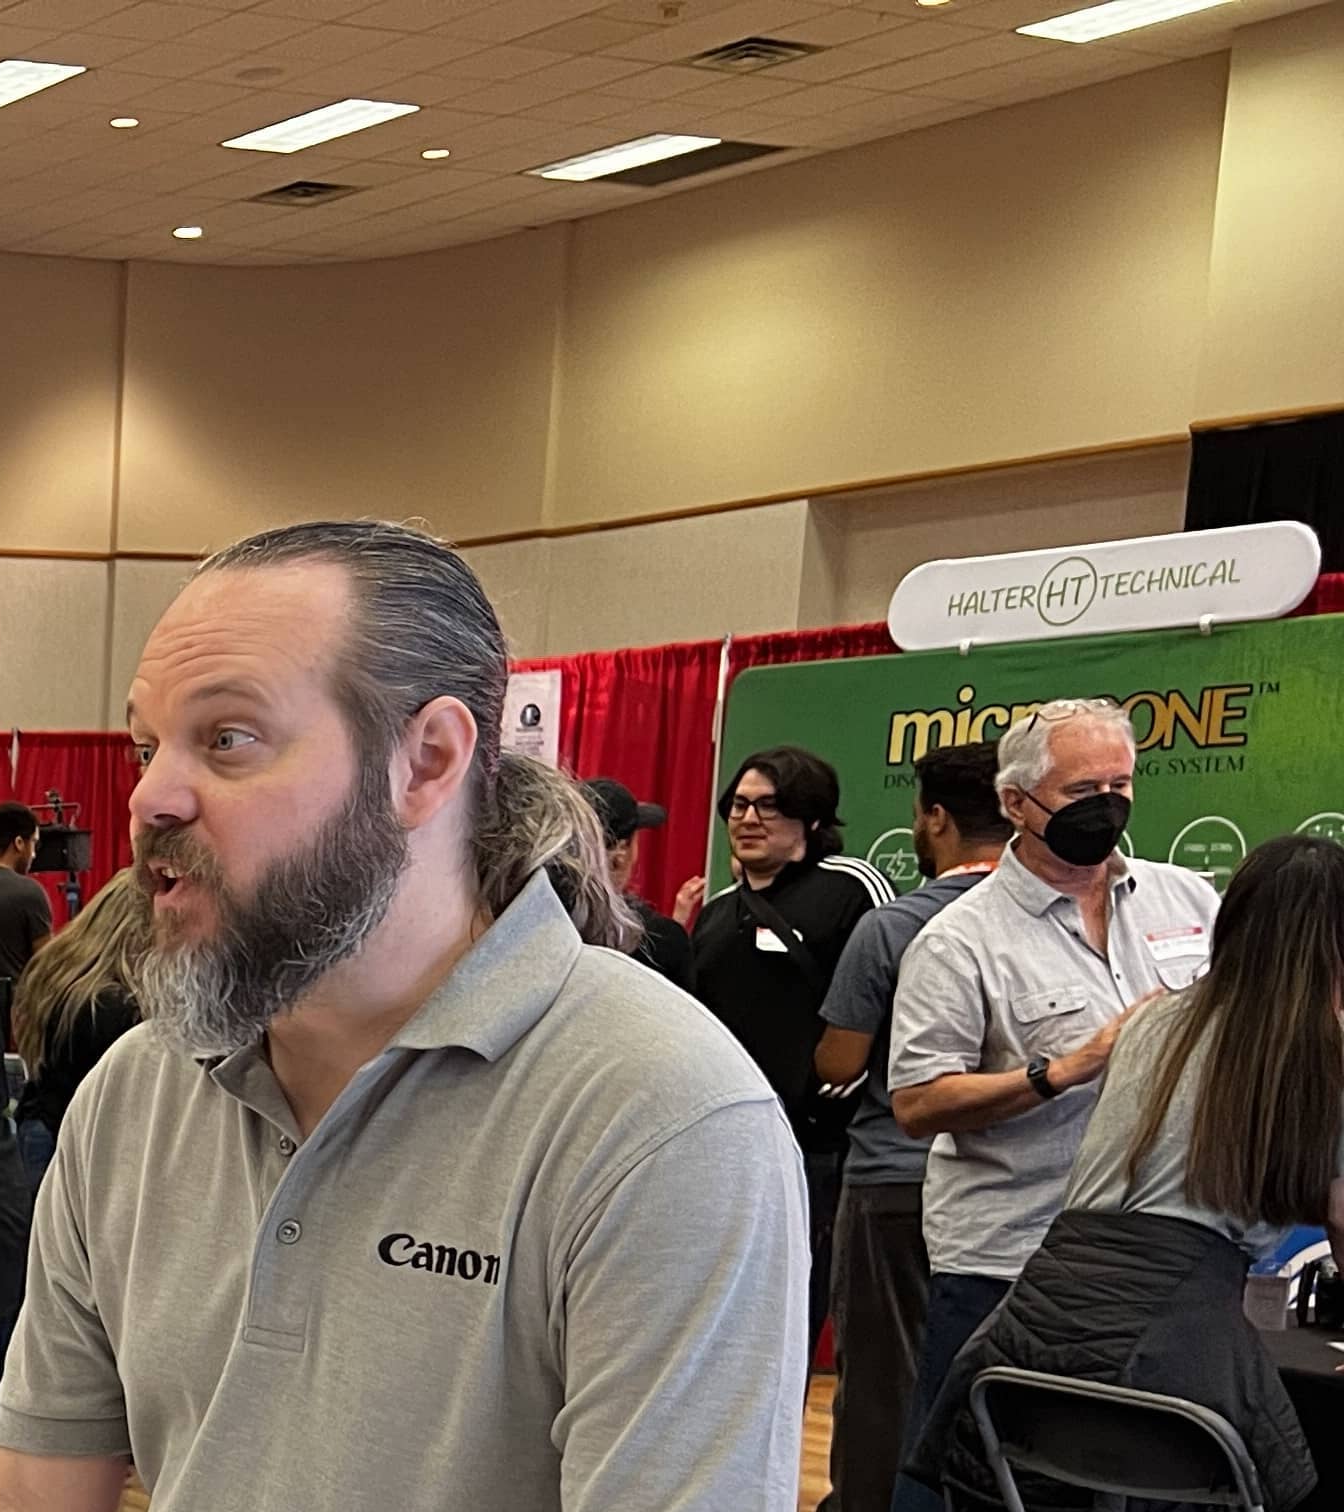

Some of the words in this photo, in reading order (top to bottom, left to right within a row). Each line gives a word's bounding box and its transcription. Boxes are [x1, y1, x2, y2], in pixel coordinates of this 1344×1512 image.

[948, 585, 1036, 616] HALTER
[1047, 575, 1091, 609] HT
[1100, 559, 1241, 599] TECHNICAL
[1167, 755, 1245, 776] SYSTEM
[378, 1233, 501, 1285] Canon
